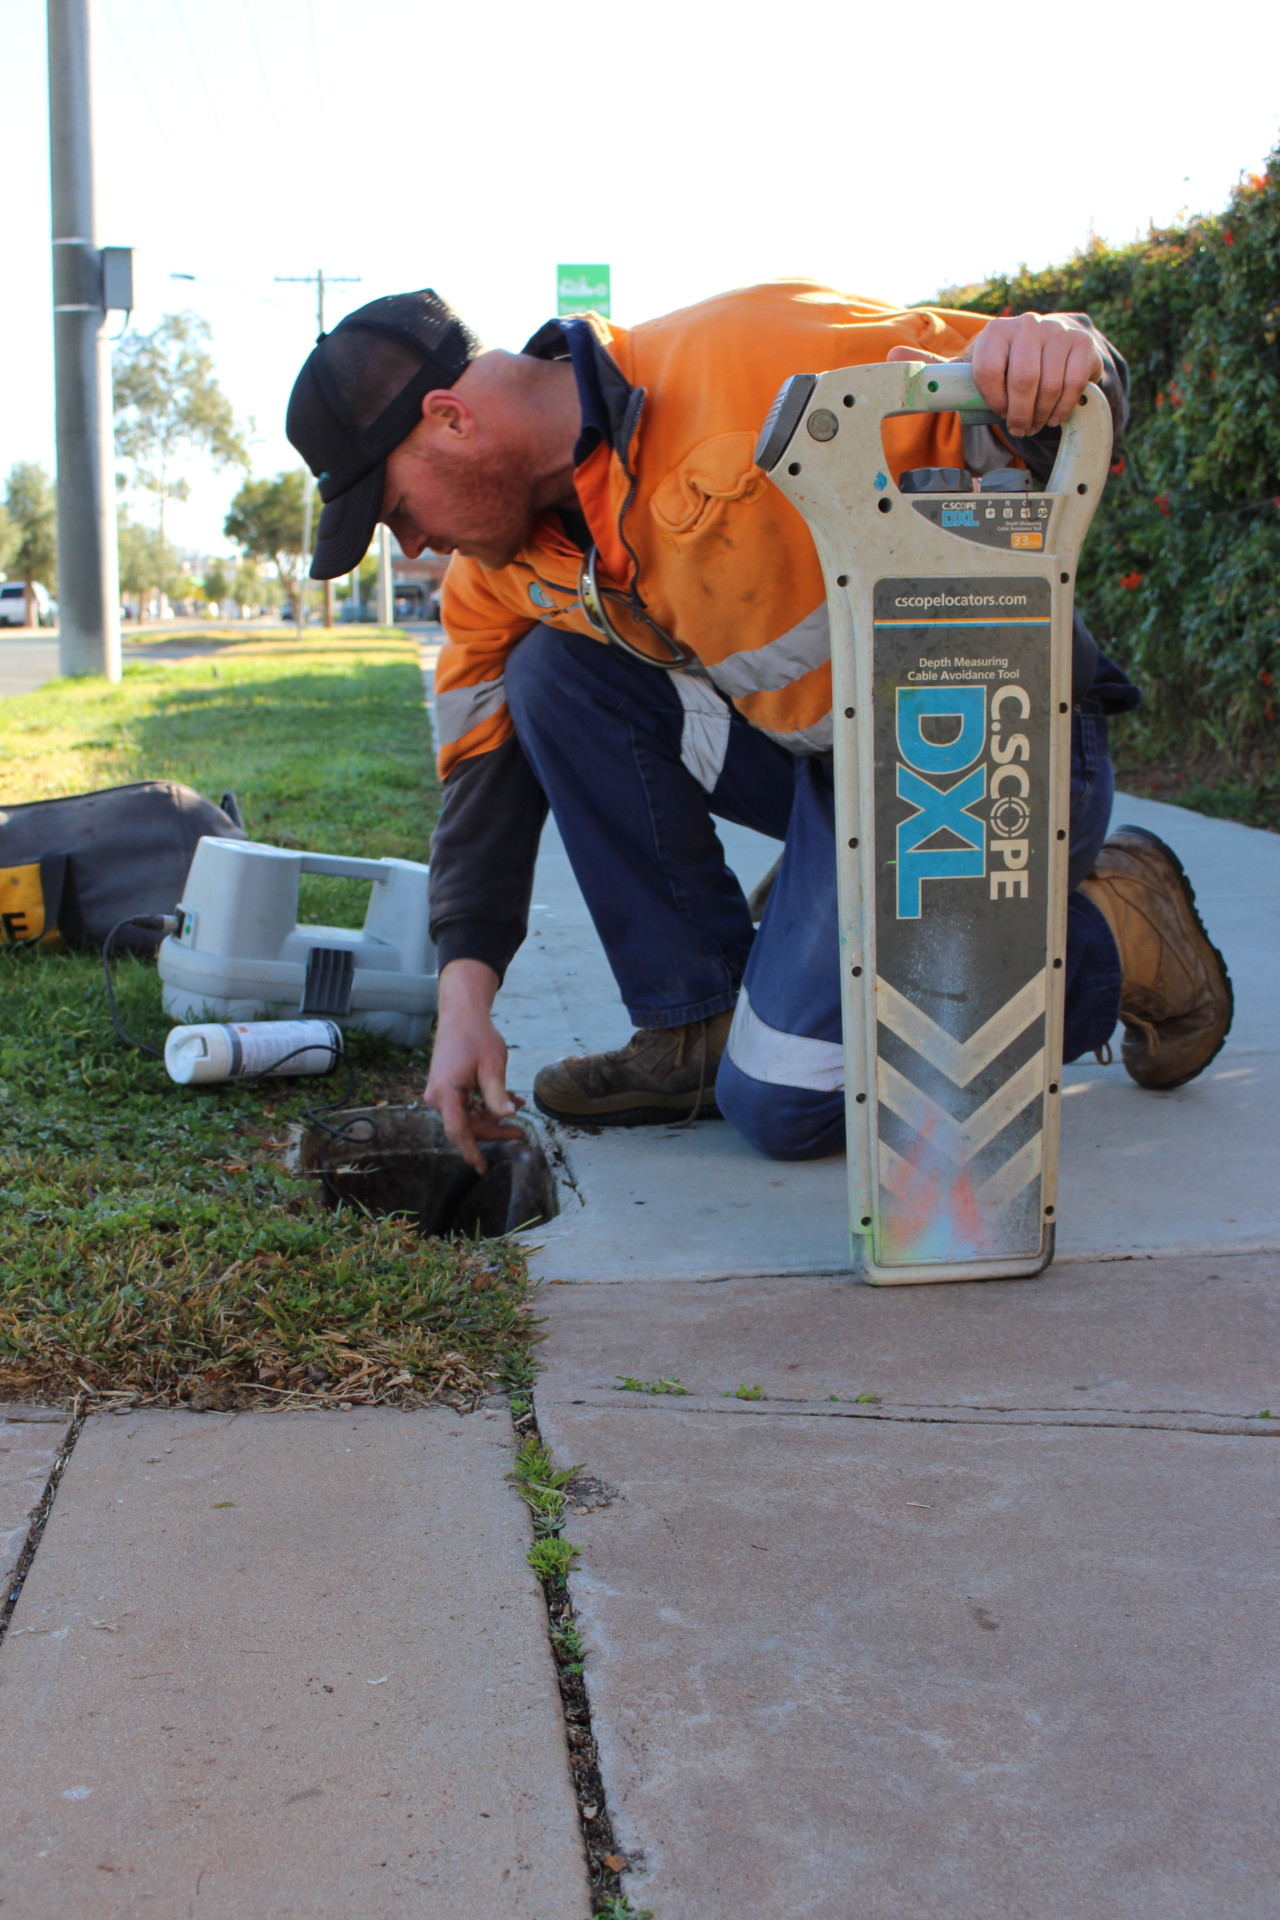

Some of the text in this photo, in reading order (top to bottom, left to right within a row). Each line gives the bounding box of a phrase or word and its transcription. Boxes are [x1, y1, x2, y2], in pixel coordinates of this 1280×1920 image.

[941, 510, 980, 527] DXL
[894, 593, 1027, 610] cscopelocators.com
[919, 656, 1009, 669] Depth Measuring
[907, 668, 1020, 681] Cable Avoidance Tool
[896, 685, 987, 920] DXL
